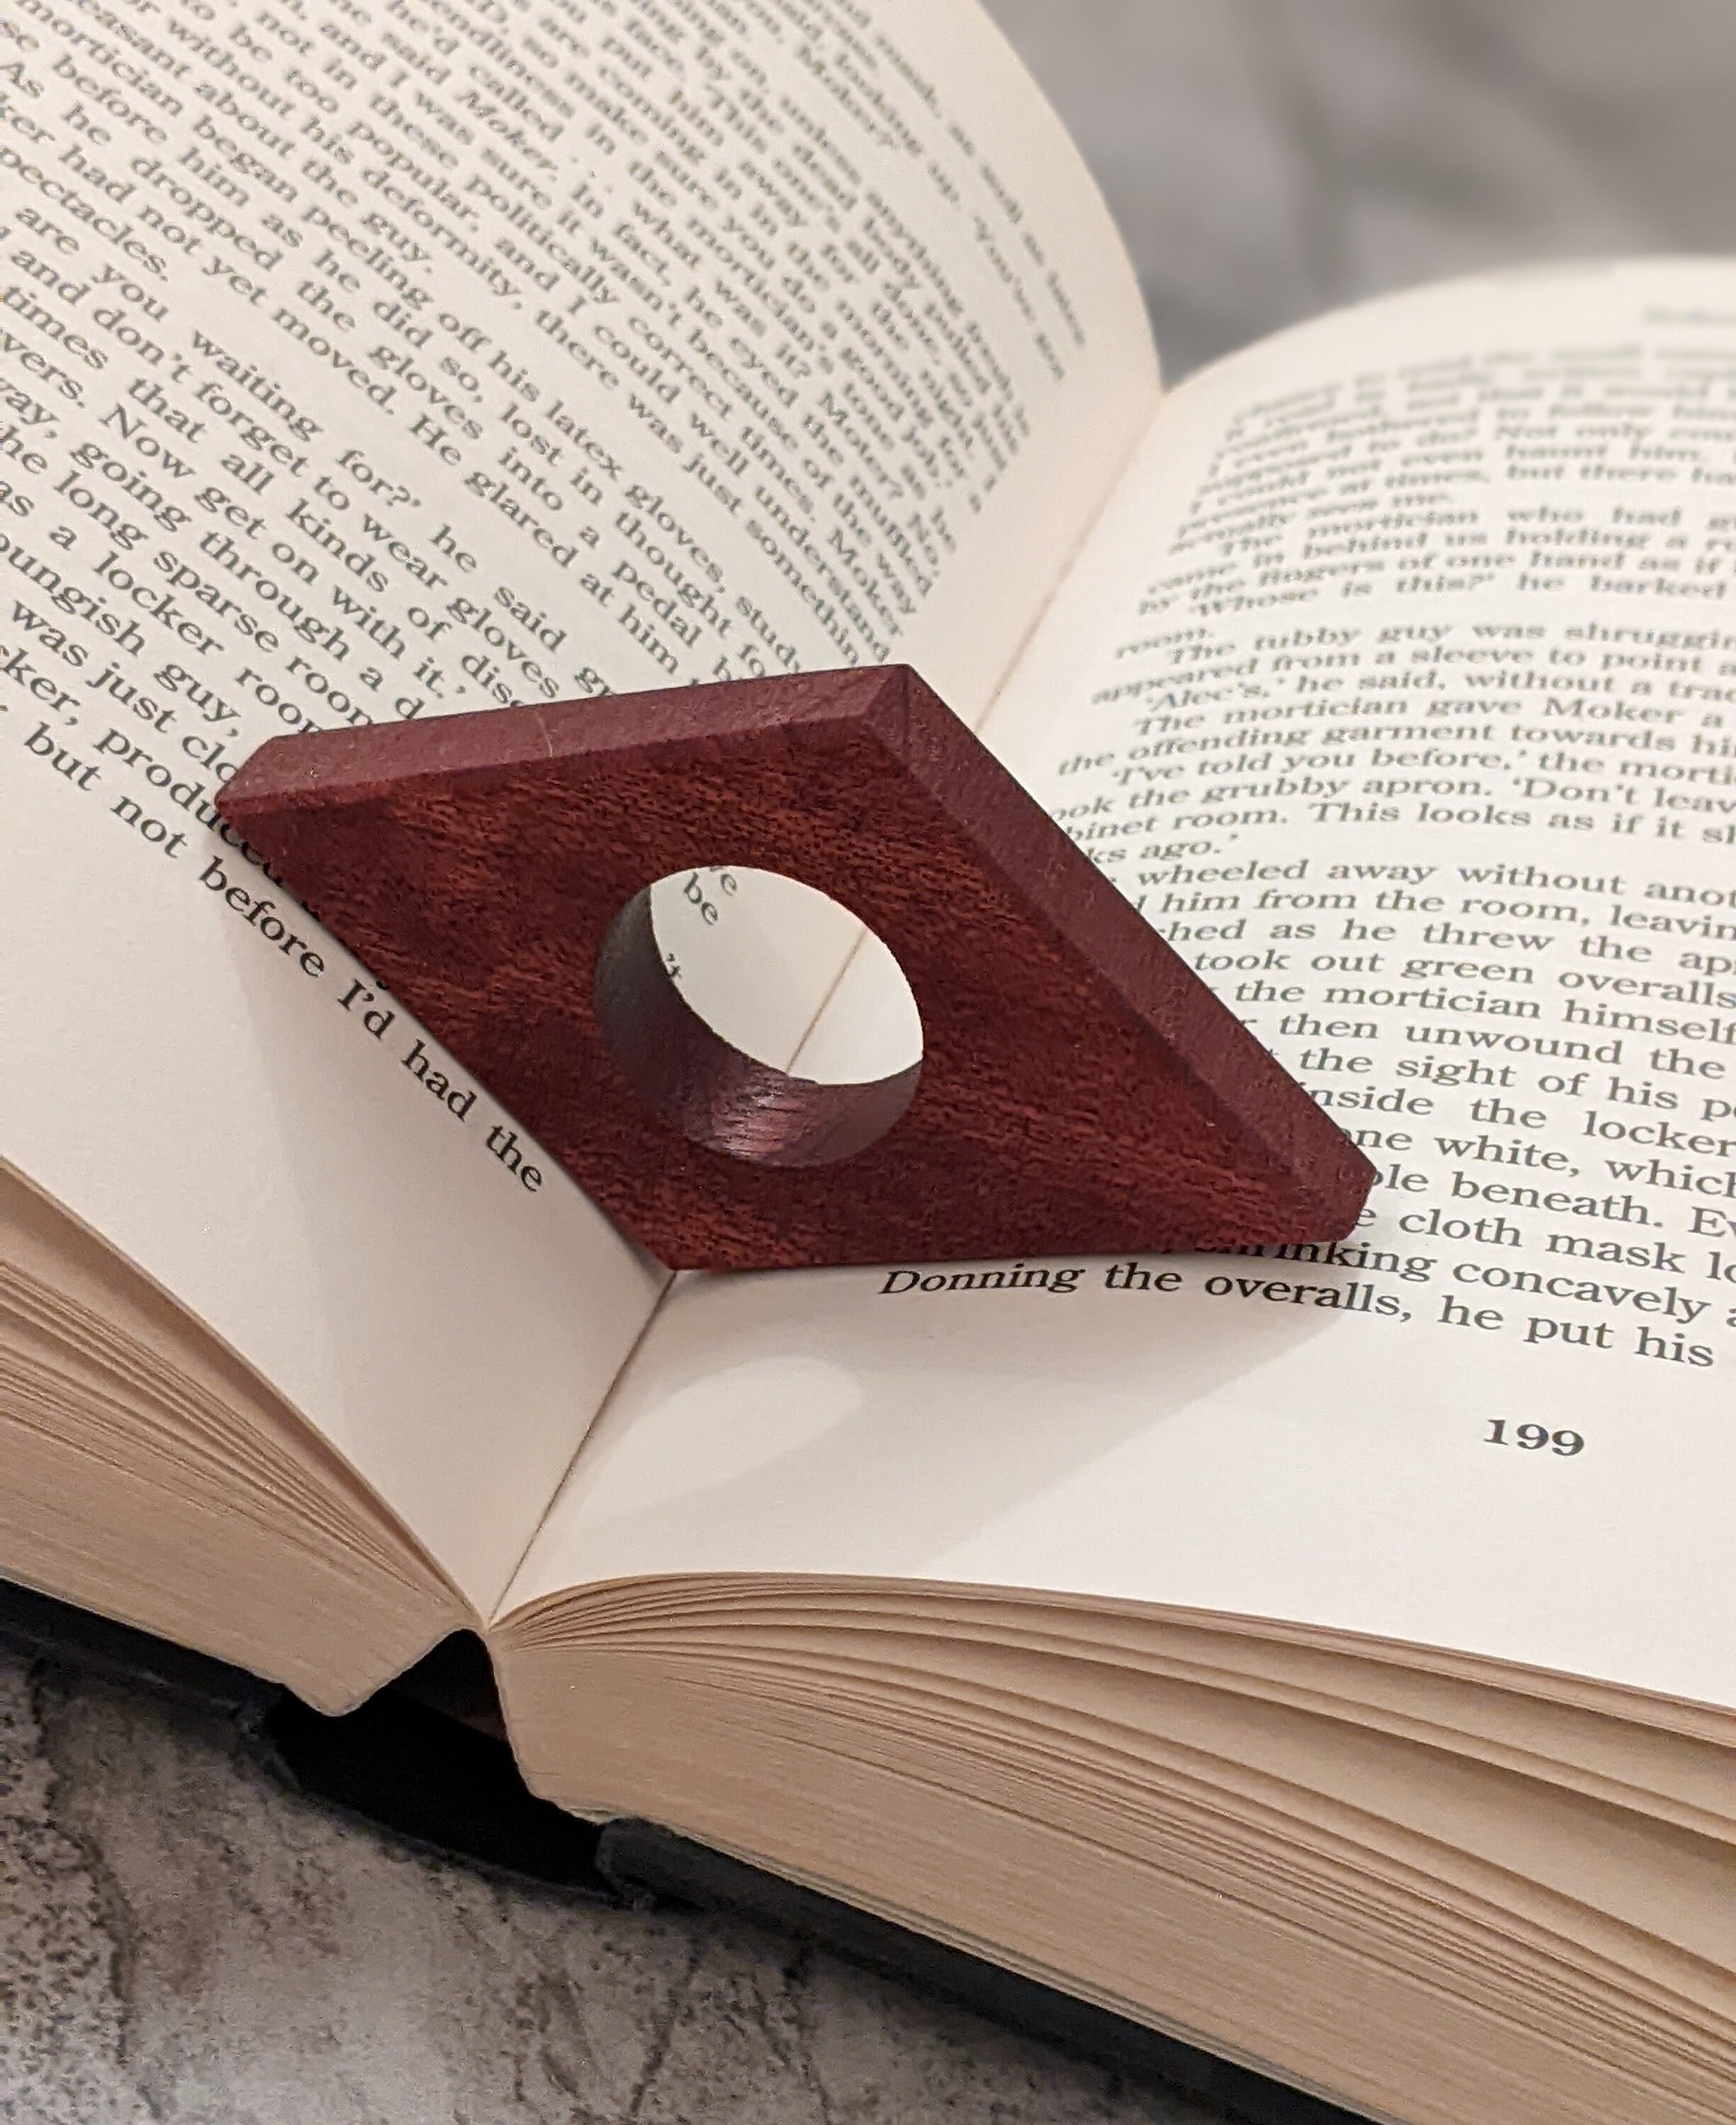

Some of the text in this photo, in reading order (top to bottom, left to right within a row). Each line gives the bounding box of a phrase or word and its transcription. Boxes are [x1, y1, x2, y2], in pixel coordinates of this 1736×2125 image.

[193, 82, 296, 159] about
[14, 0, 726, 594] mortician began peeling off latex gloves,
[167, 18, 742, 515] without there was just
[632, 200, 766, 338] what was
[51, 52, 732, 638] before him as he did so, lost thought
[62, 102, 112, 146] he
[130, 157, 285, 272] dropped
[296, 280, 356, 329] the
[366, 345, 484, 441] gloves
[497, 445, 564, 512] into
[611, 560, 703, 649] pedal
[729, 336, 800, 409] eyed
[57, 143, 679, 676] had not yet moved. He glared at him
[463, 173, 903, 637] politically correct Moker
[686, 327, 799, 450] because
[0, 285, 453, 641] times that all kinds of
[14, 207, 81, 255] are
[90, 263, 169, 323] you
[192, 329, 324, 443] waiting
[429, 523, 477, 573] he
[493, 586, 568, 653] said
[494, 237, 890, 662] and could well understand
[8, 249, 560, 699] and don't forget to wear gloves
[52, 469, 279, 654] long sparse
[98, 402, 196, 479] Now
[193, 486, 267, 540] get
[271, 541, 319, 586] on
[331, 584, 407, 661] with
[1505, 526, 1651, 550] holding
[1530, 549, 1626, 570] hand
[48, 525, 225, 656] a locker
[69, 442, 384, 693] going through a
[1589, 574, 1728, 601] barked
[11, 599, 176, 735] was just
[1377, 624, 1546, 645] guy was
[1411, 645, 1702, 673] sleeve to point
[152, 663, 242, 738] guy,
[1223, 696, 1683, 725] mortician gave Moker
[1357, 668, 1614, 693] said, without
[1198, 752, 1273, 775] told
[1281, 754, 1355, 773] you
[1538, 750, 1605, 773] the
[1320, 724, 1676, 752] garment towards
[1128, 788, 1191, 810] the
[1201, 776, 1350, 803] grubby
[1361, 779, 1492, 798] apron.
[1172, 801, 1682, 839] room. This looks as it
[1138, 858, 1621, 895] wheeled away without
[1160, 888, 1590, 926] him from the room,
[23, 720, 543, 1194] but not before I'd had the
[1194, 948, 1290, 971] took
[1310, 952, 1385, 973] out
[1400, 959, 1534, 985] green
[1269, 917, 1653, 963] as he threw the
[1235, 978, 1541, 1019] the mortician
[1278, 1012, 1726, 1080] then unwound the
[1299, 1046, 1679, 1110] the sight of his
[1433, 1134, 1580, 1178] white,
[1470, 1097, 1736, 1158] the locker
[1451, 1170, 1664, 1228] beneath.
[1398, 1208, 1686, 1274] cloth mask
[878, 1261, 1715, 1368] Donning the overalls, he put his
[1452, 1262, 1713, 1325] concavely
[1482, 1418, 1585, 1457] 199
